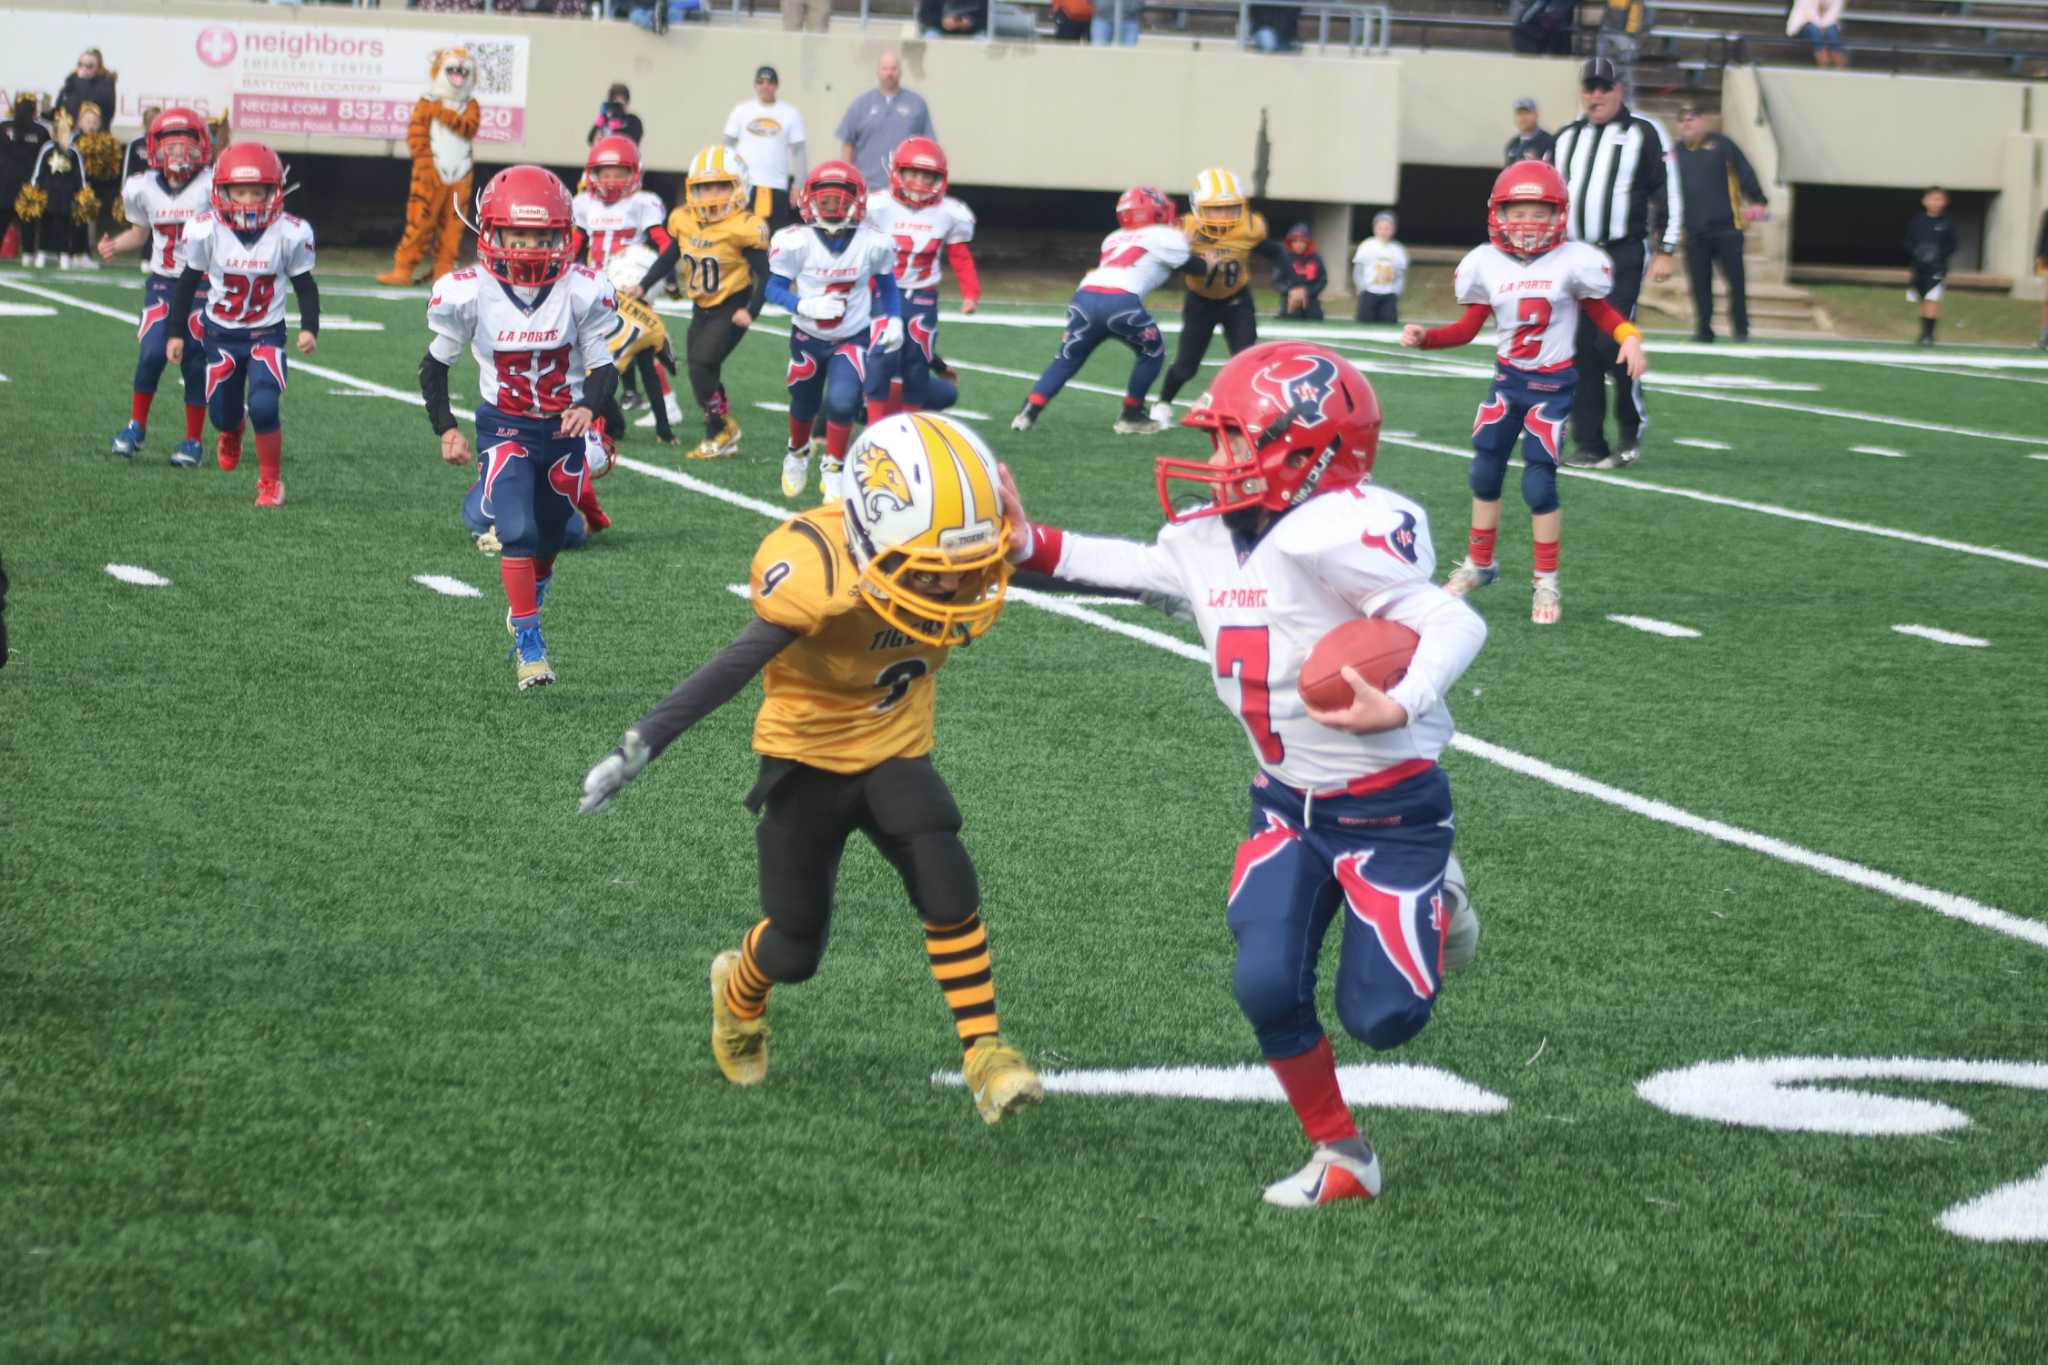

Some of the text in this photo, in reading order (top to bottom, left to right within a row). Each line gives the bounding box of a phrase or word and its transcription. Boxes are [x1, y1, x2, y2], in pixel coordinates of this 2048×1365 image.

[245, 31, 384, 59] neighbors
[241, 78, 382, 93] BAYTOWN LOCATION
[240, 100, 328, 117] NEC24.COM
[337, 99, 411, 122] 832.6
[683, 253, 722, 294] 20
[1498, 279, 1553, 294] LA PORTE
[212, 272, 277, 324] 39
[496, 329, 559, 343] LA PORTE
[1508, 297, 1553, 360] 2
[493, 342, 574, 419] 52
[761, 561, 791, 597] 9
[1208, 588, 1269, 609] LA PORTE
[1215, 624, 1285, 766] 7
